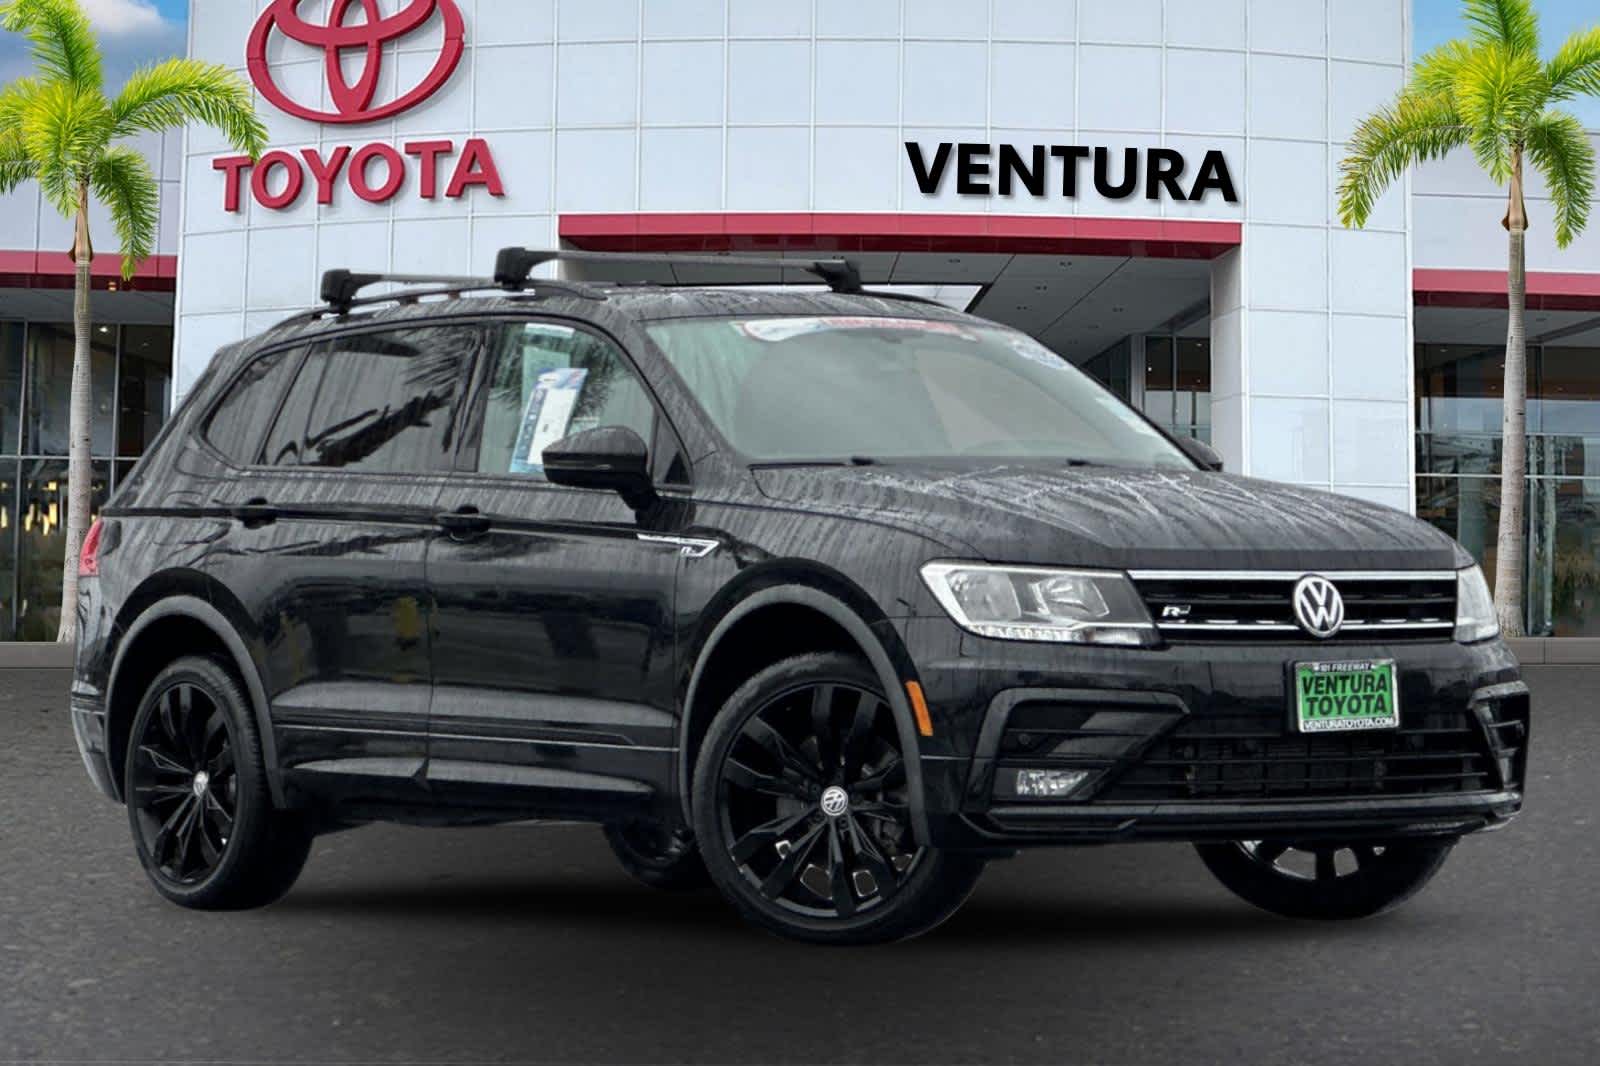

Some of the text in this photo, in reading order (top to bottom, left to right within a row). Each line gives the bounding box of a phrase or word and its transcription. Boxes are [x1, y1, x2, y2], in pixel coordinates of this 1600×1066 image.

[213, 138, 505, 212] TOYOTA
[904, 142, 1238, 203] VENTURA
[1302, 674, 1388, 695] VENTURA
[1305, 694, 1387, 717] TOYOTA
